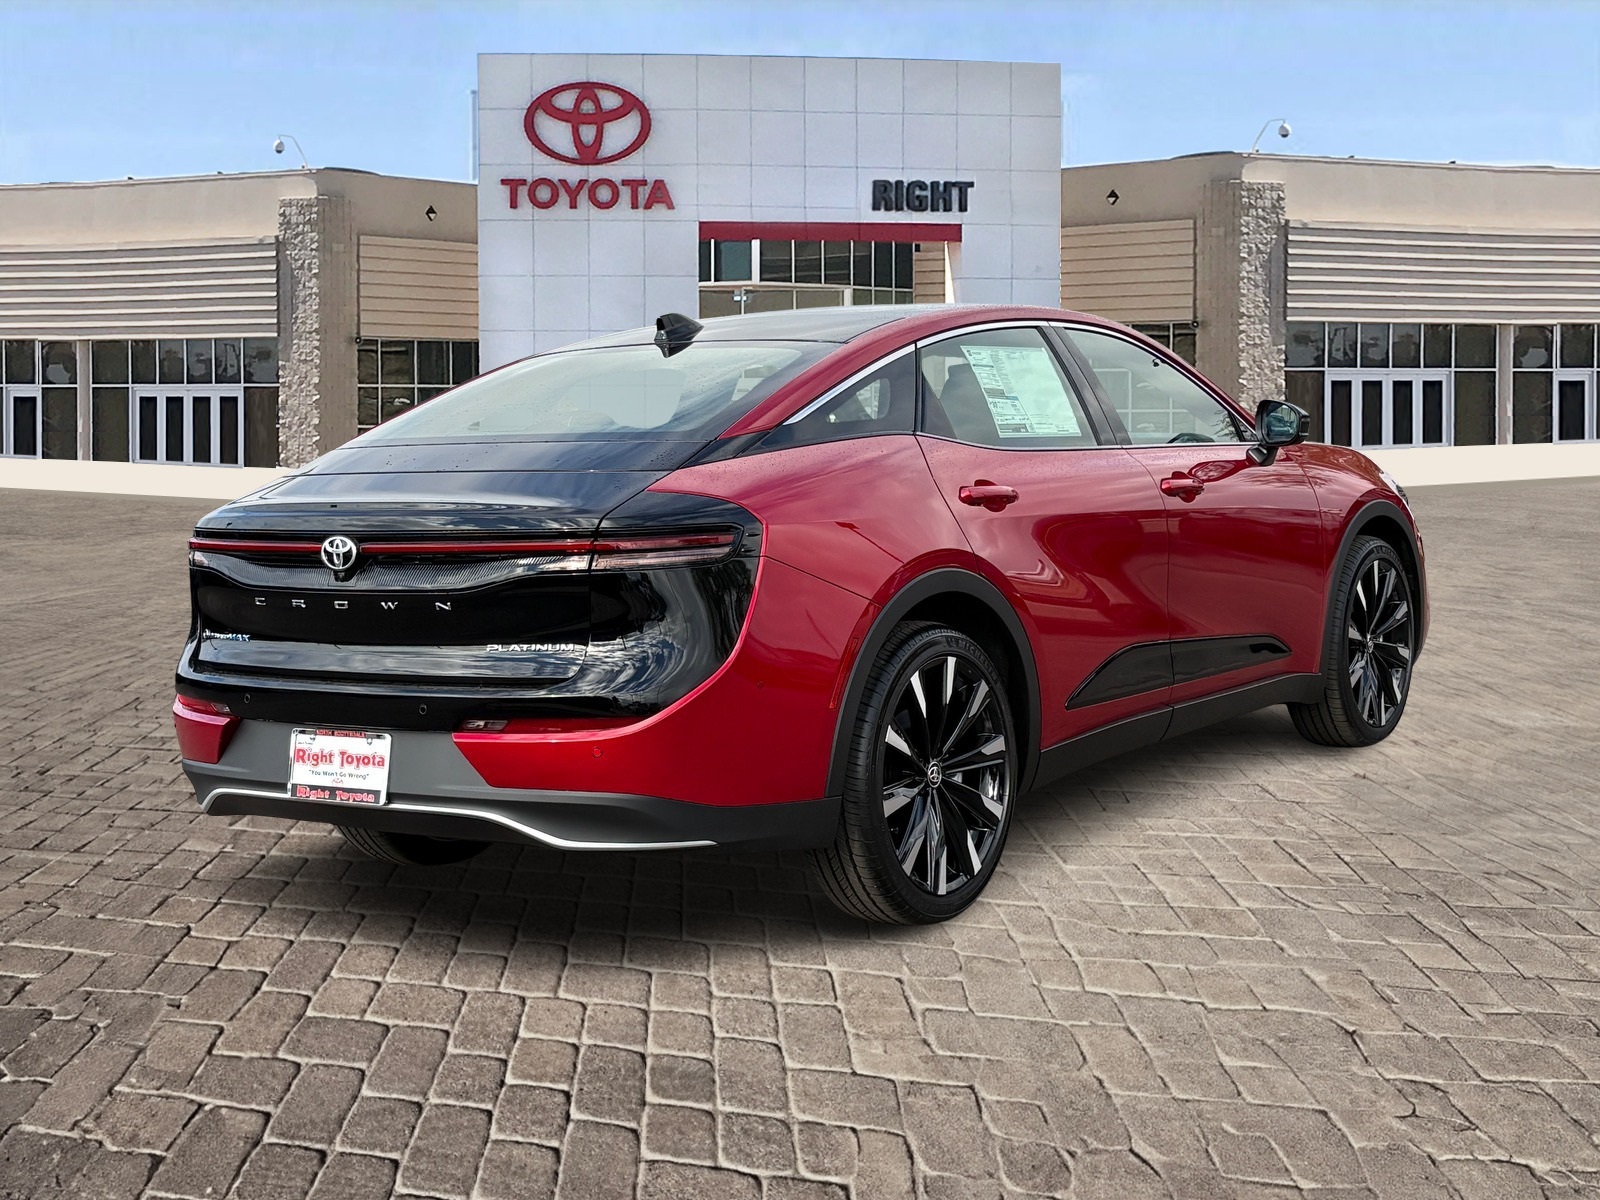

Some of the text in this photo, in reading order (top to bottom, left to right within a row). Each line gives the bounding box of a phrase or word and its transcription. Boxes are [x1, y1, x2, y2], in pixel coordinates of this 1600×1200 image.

[500, 178, 675, 210] TOYOTA
[871, 179, 975, 213] RIGHT
[254, 597, 452, 611] CROWN
[486, 643, 575, 653] PLATINUM
[294, 747, 386, 769] Right Toyota
[296, 785, 375, 803] Right Toyota
